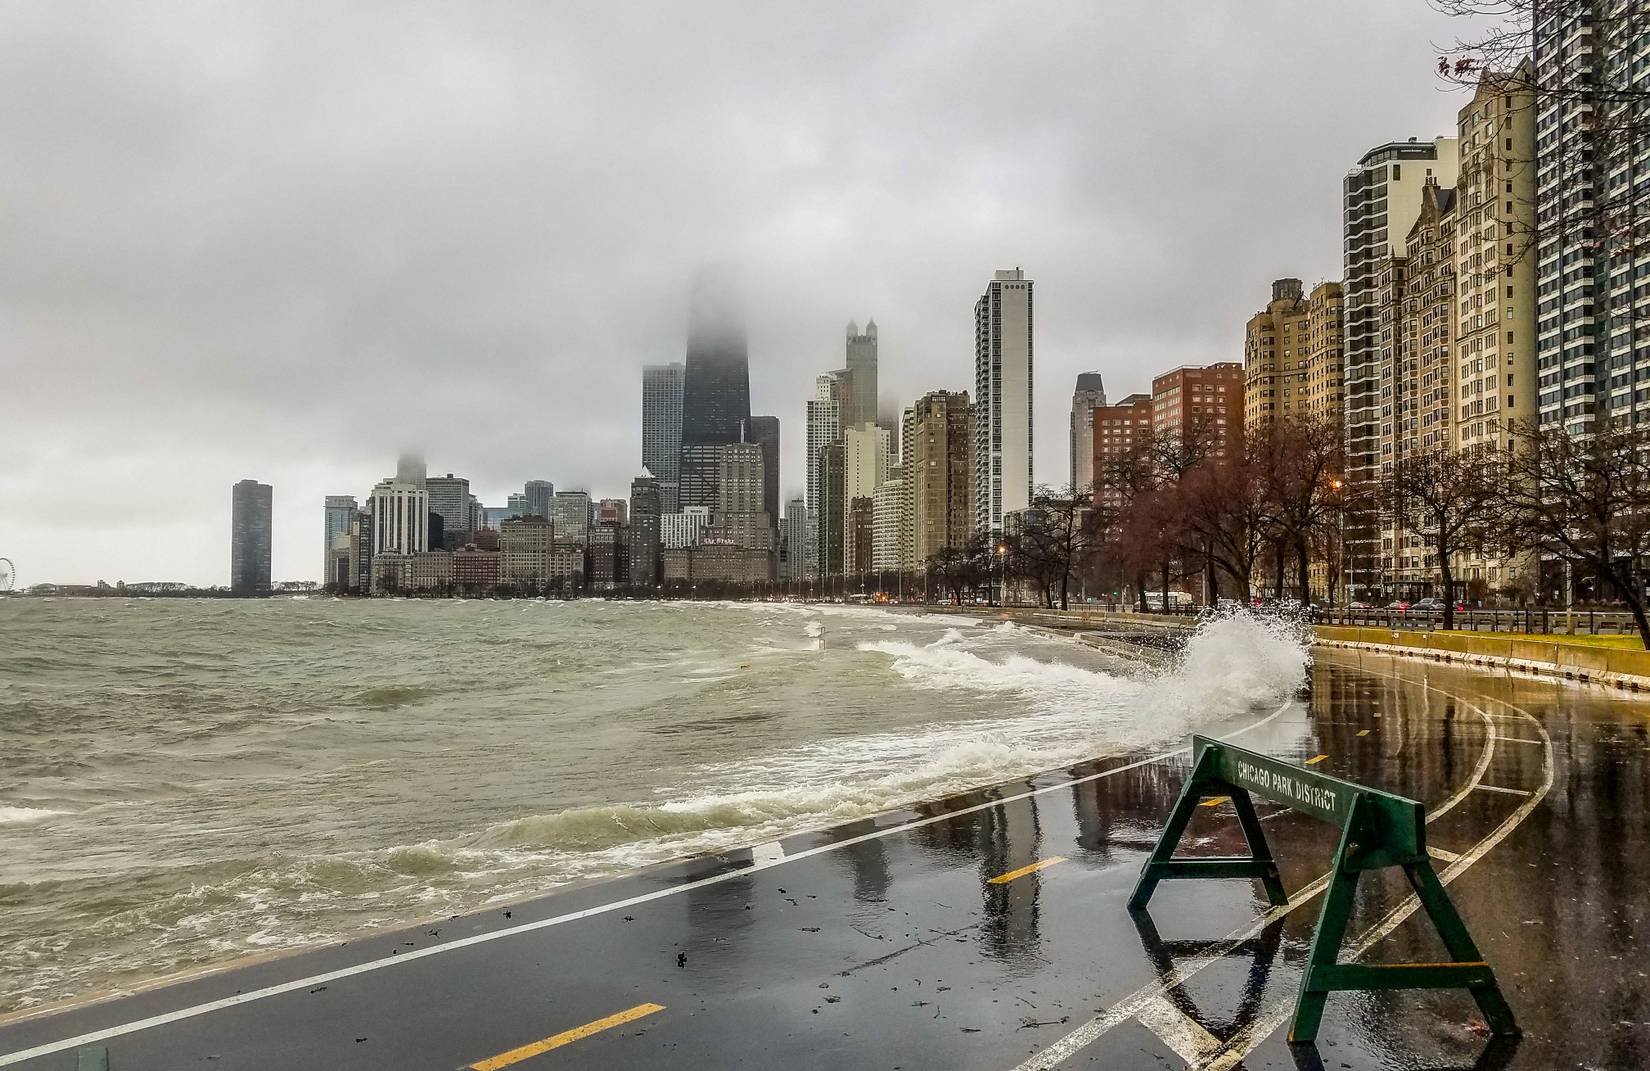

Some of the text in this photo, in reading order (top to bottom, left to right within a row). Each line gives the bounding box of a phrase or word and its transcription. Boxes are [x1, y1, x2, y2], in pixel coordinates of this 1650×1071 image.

[1237, 760, 1336, 812] CHICAGO PARK DISTRICT
